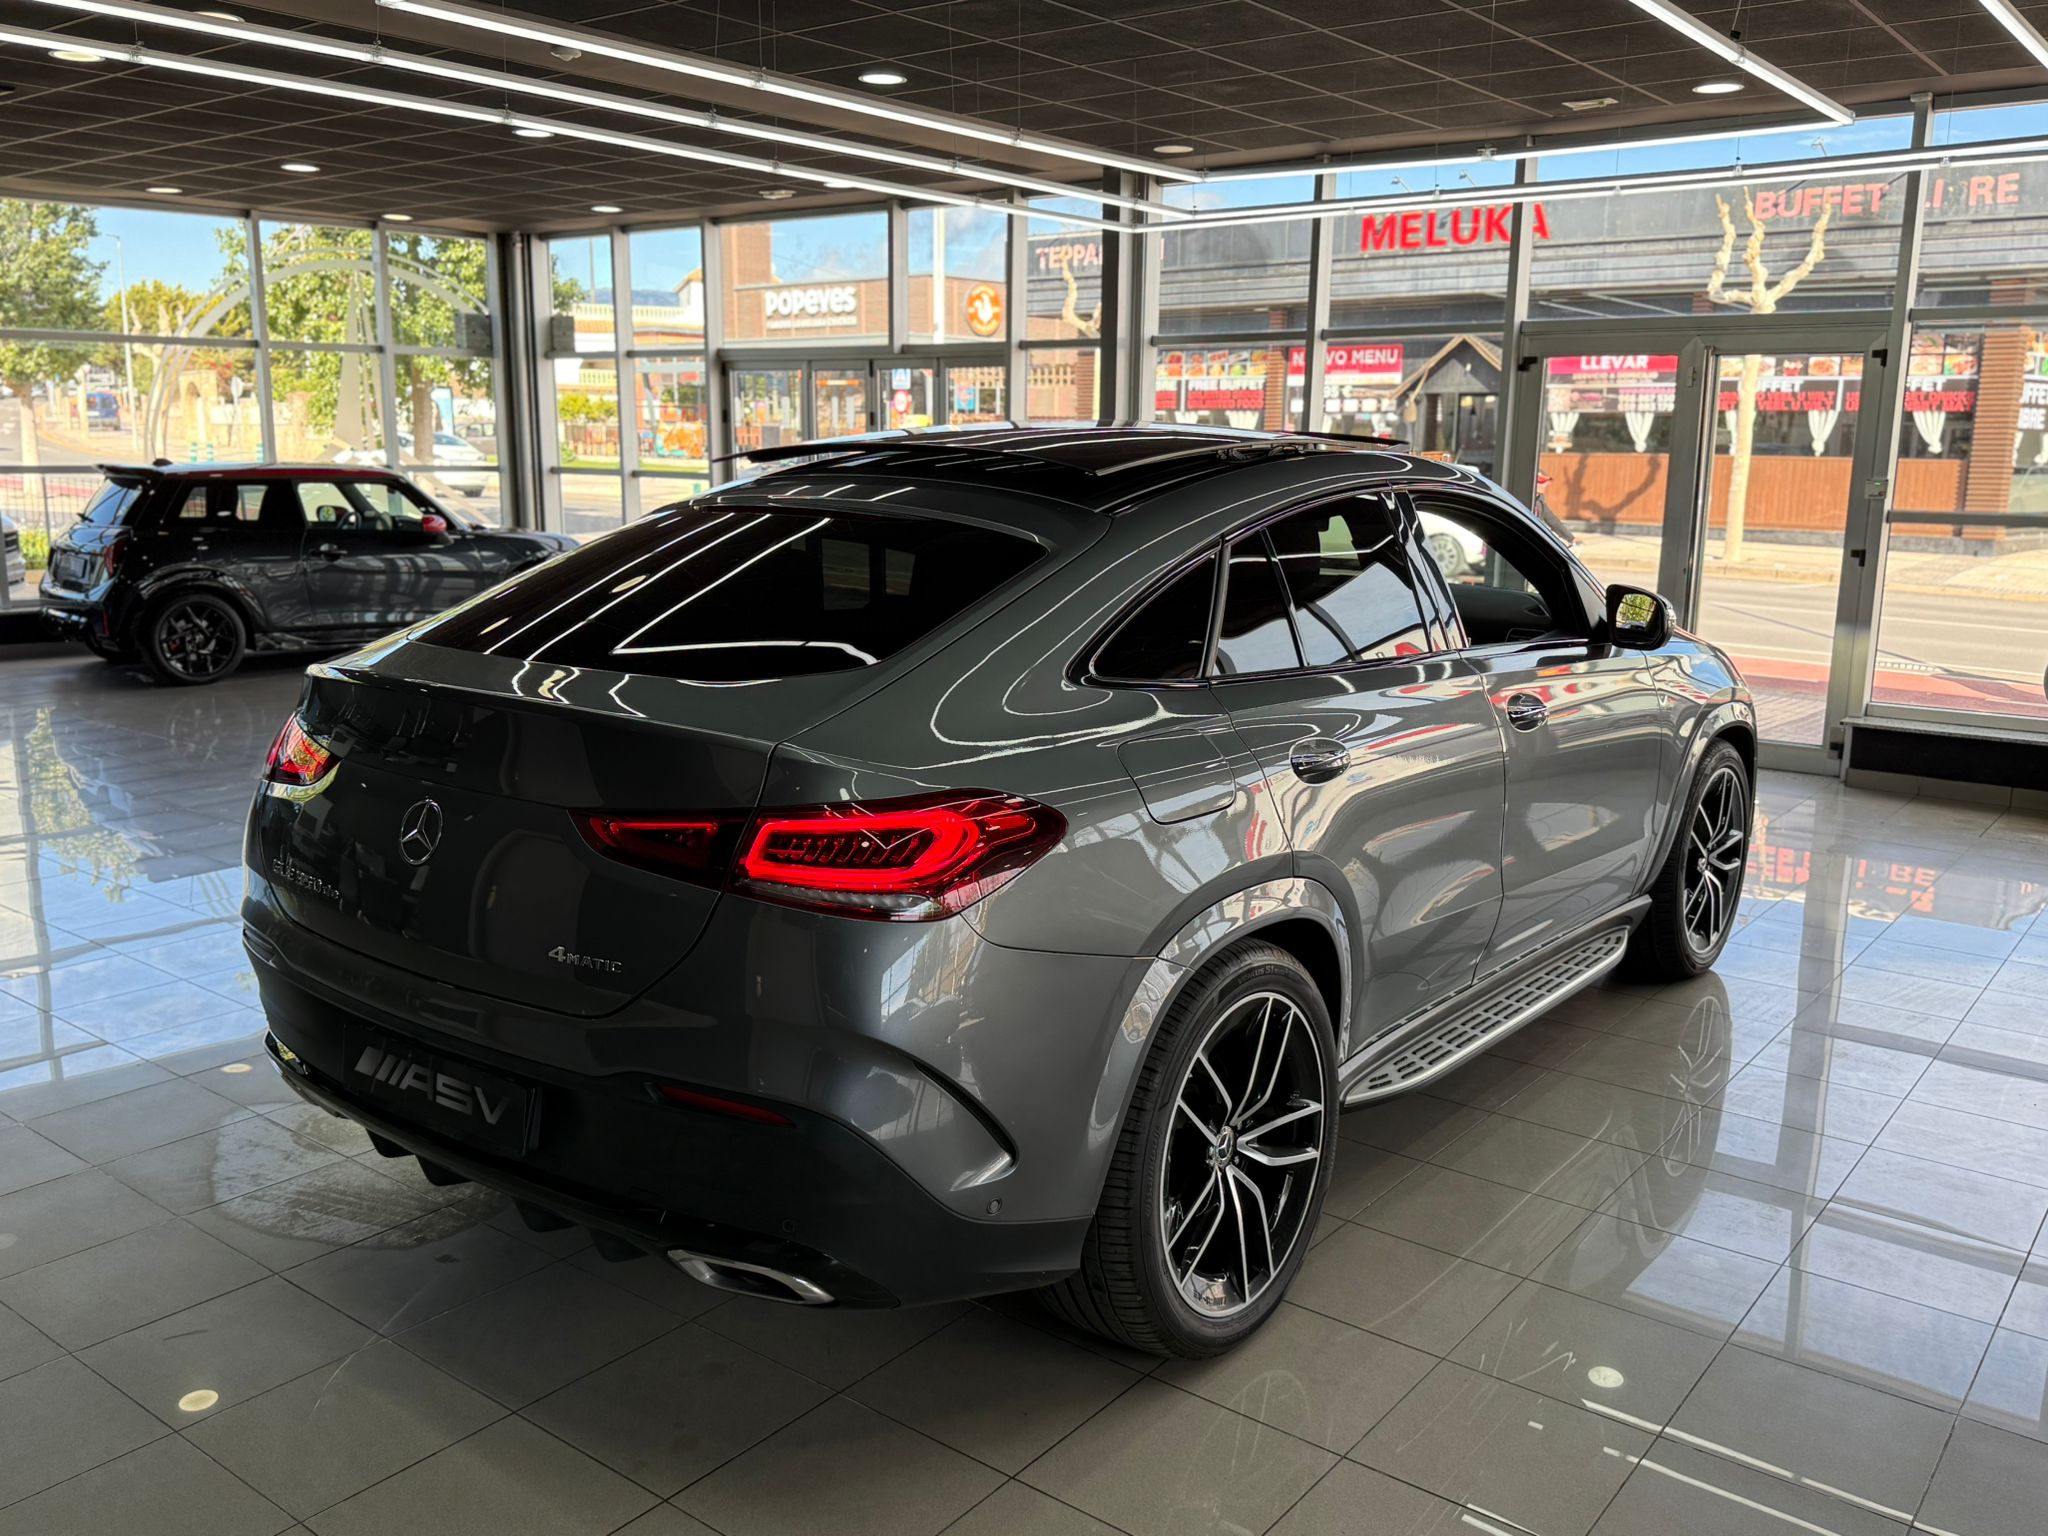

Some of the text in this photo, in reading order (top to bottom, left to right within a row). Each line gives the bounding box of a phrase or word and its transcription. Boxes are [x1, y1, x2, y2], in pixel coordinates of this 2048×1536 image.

[1755, 183, 1890, 220] BUFFET
[1351, 348, 1399, 366] MENU
[1580, 355, 1649, 370] LLEVAR
